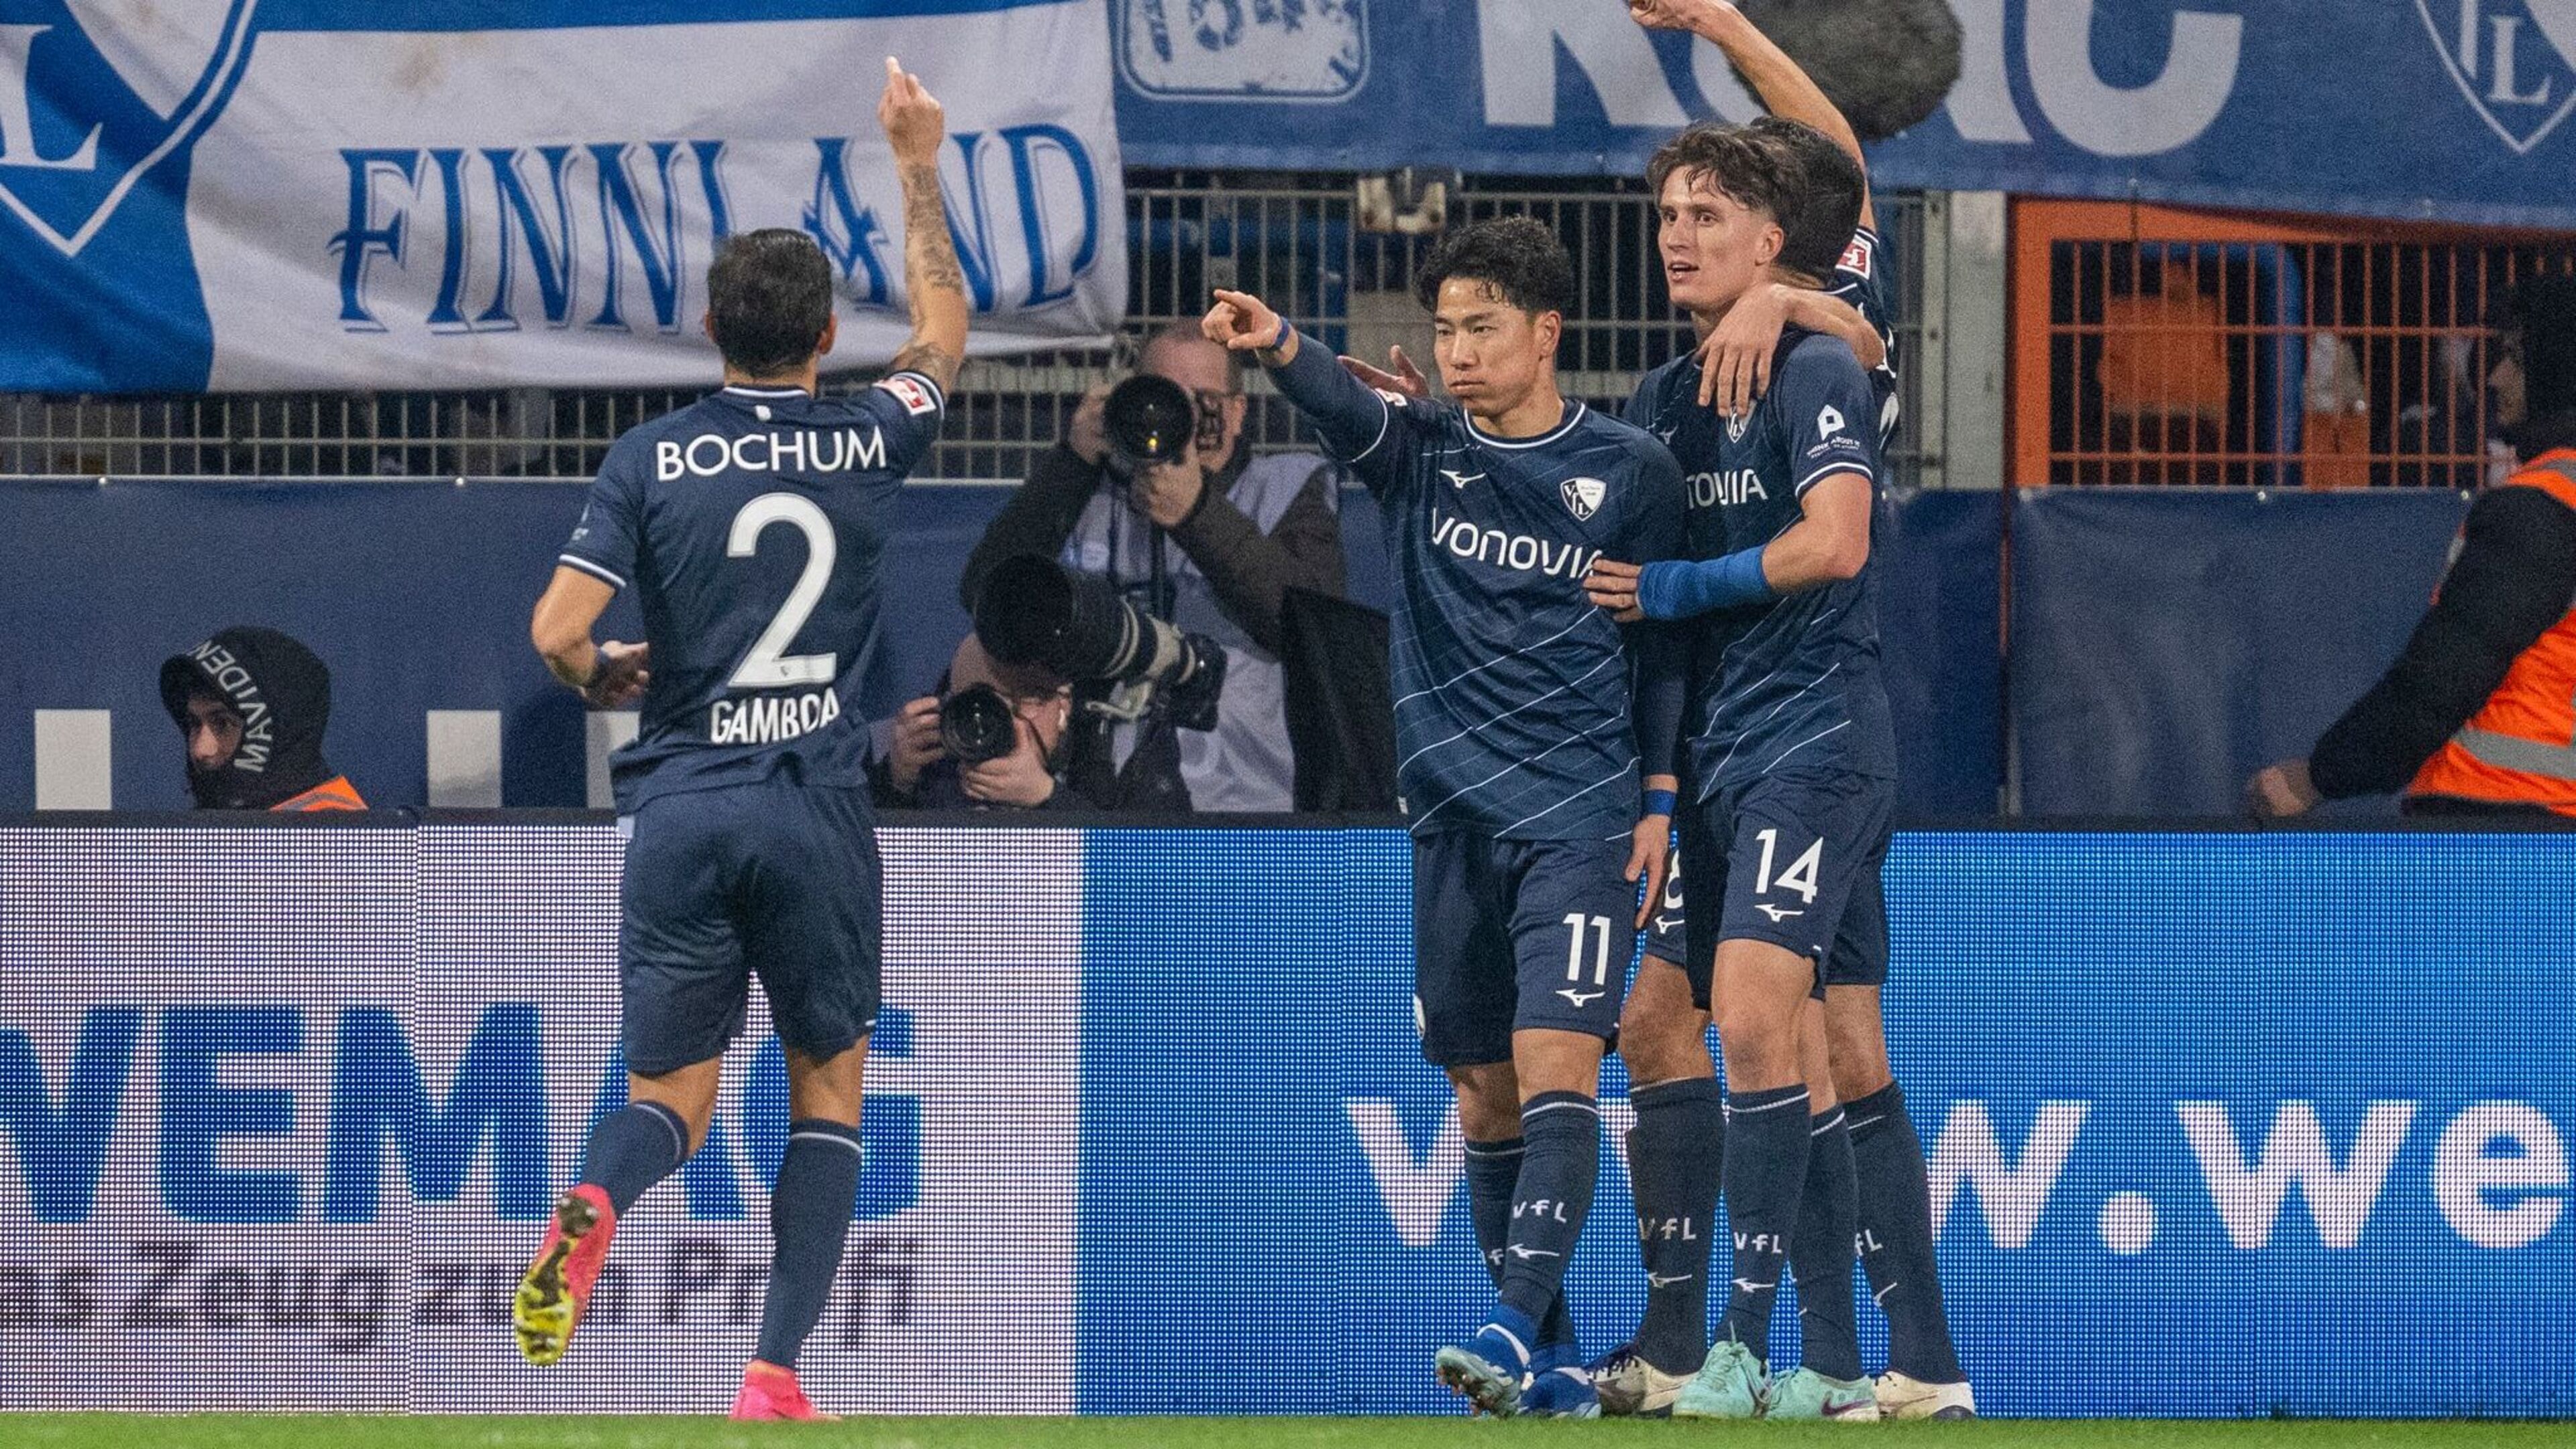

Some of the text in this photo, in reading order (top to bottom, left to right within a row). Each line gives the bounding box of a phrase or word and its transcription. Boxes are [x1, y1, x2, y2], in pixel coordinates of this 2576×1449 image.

[656, 427, 887, 482] BOCHUM
[727, 492, 837, 688] 2
[710, 687, 840, 744] GAMBOA
[1755, 828, 1824, 904] 14
[1562, 912, 1611, 985] 11
[1342, 1098, 2571, 1256] ww.we
[1513, 1199, 1567, 1224] VfL
[1638, 1217, 1697, 1241] VfL
[1733, 1232, 1782, 1254] VfL
[121, 1240, 388, 1354] Zeug
[413, 1261, 628, 1328] zu
[664, 1234, 920, 1350] Prfi
